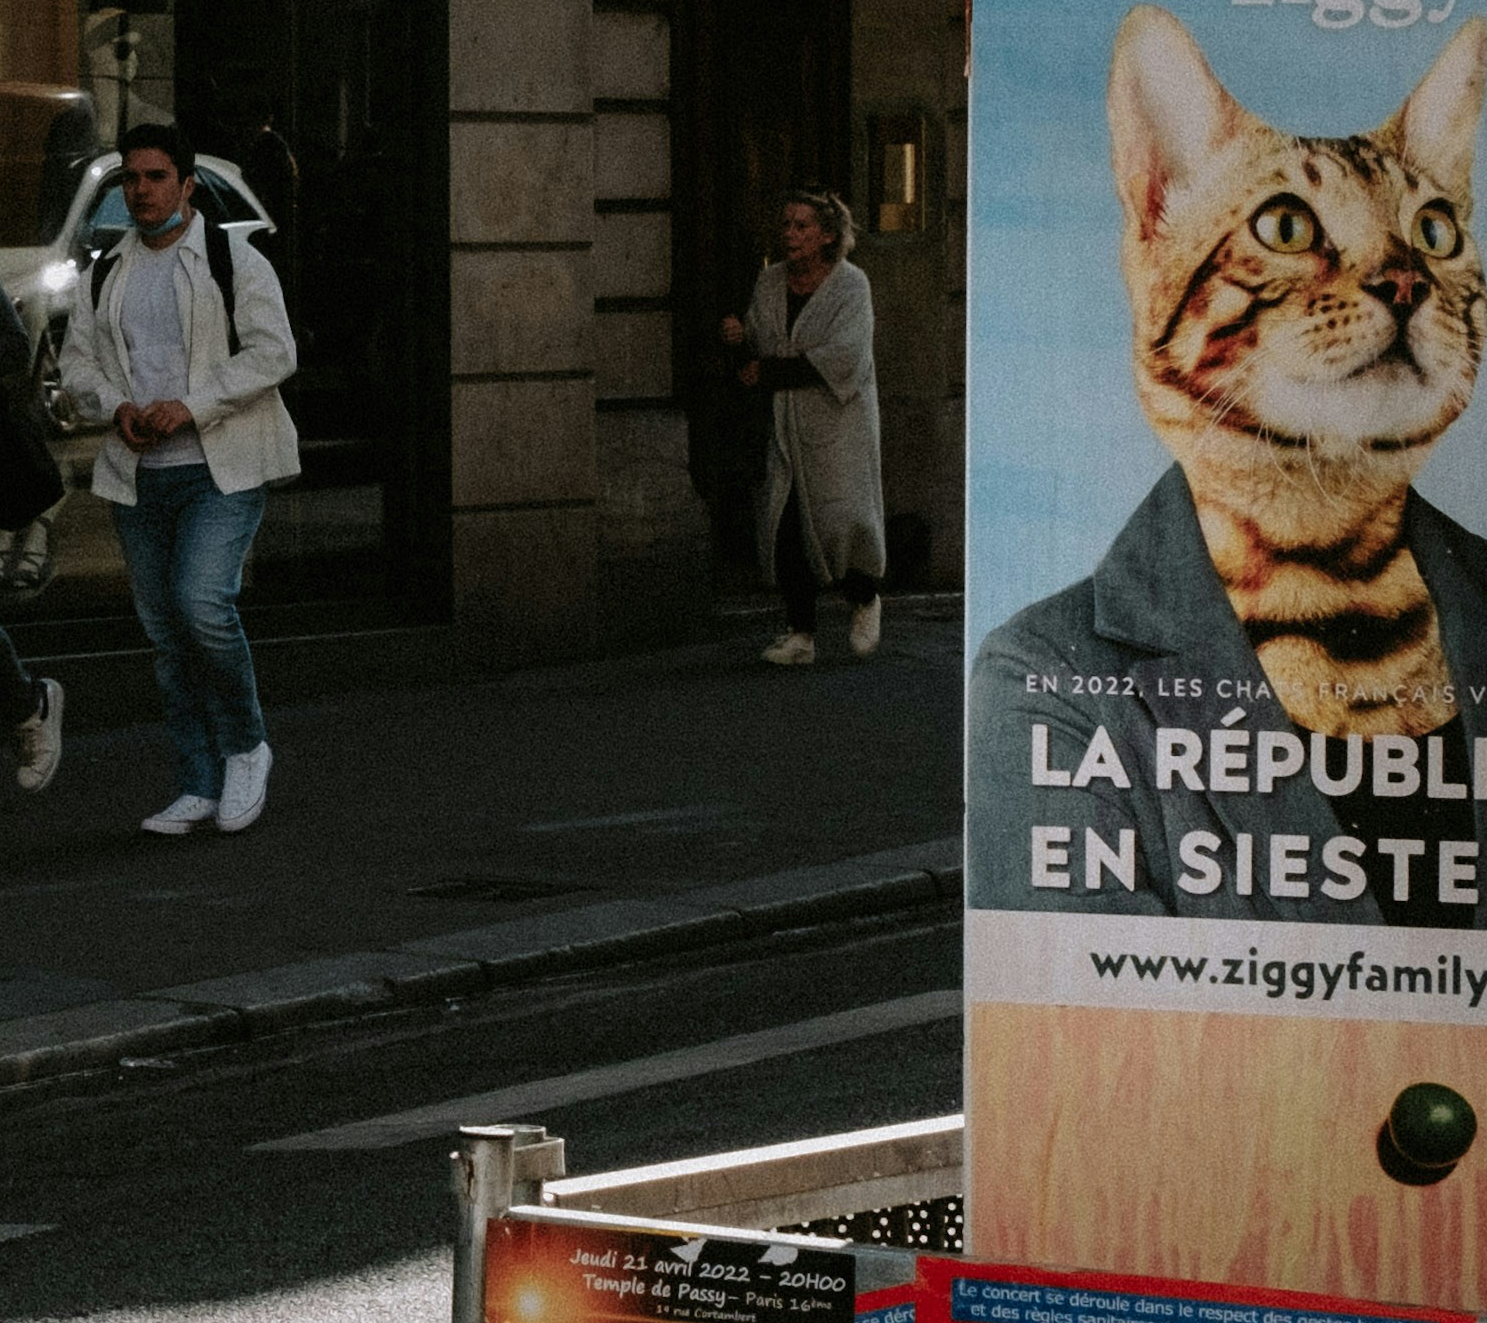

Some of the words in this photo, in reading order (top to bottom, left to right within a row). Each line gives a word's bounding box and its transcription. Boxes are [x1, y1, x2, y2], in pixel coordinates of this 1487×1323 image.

[1025, 674, 1059, 694] EN
[1072, 676, 1143, 698] 2022,
[1158, 678, 1203, 699] LES
[1216, 679, 1303, 701] CHATS
[1319, 682, 1455, 708] FRANÇAIS
[1030, 724, 1130, 789] LA
[1031, 825, 1136, 892] EN
[1177, 830, 1479, 904] SIESTE
[570, 1248, 617, 1268] Jeudi
[625, 1254, 648, 1271] 21
[655, 1259, 692, 1276] avril
[699, 1262, 750, 1282] 2022
[779, 1271, 846, 1292] 20H00
